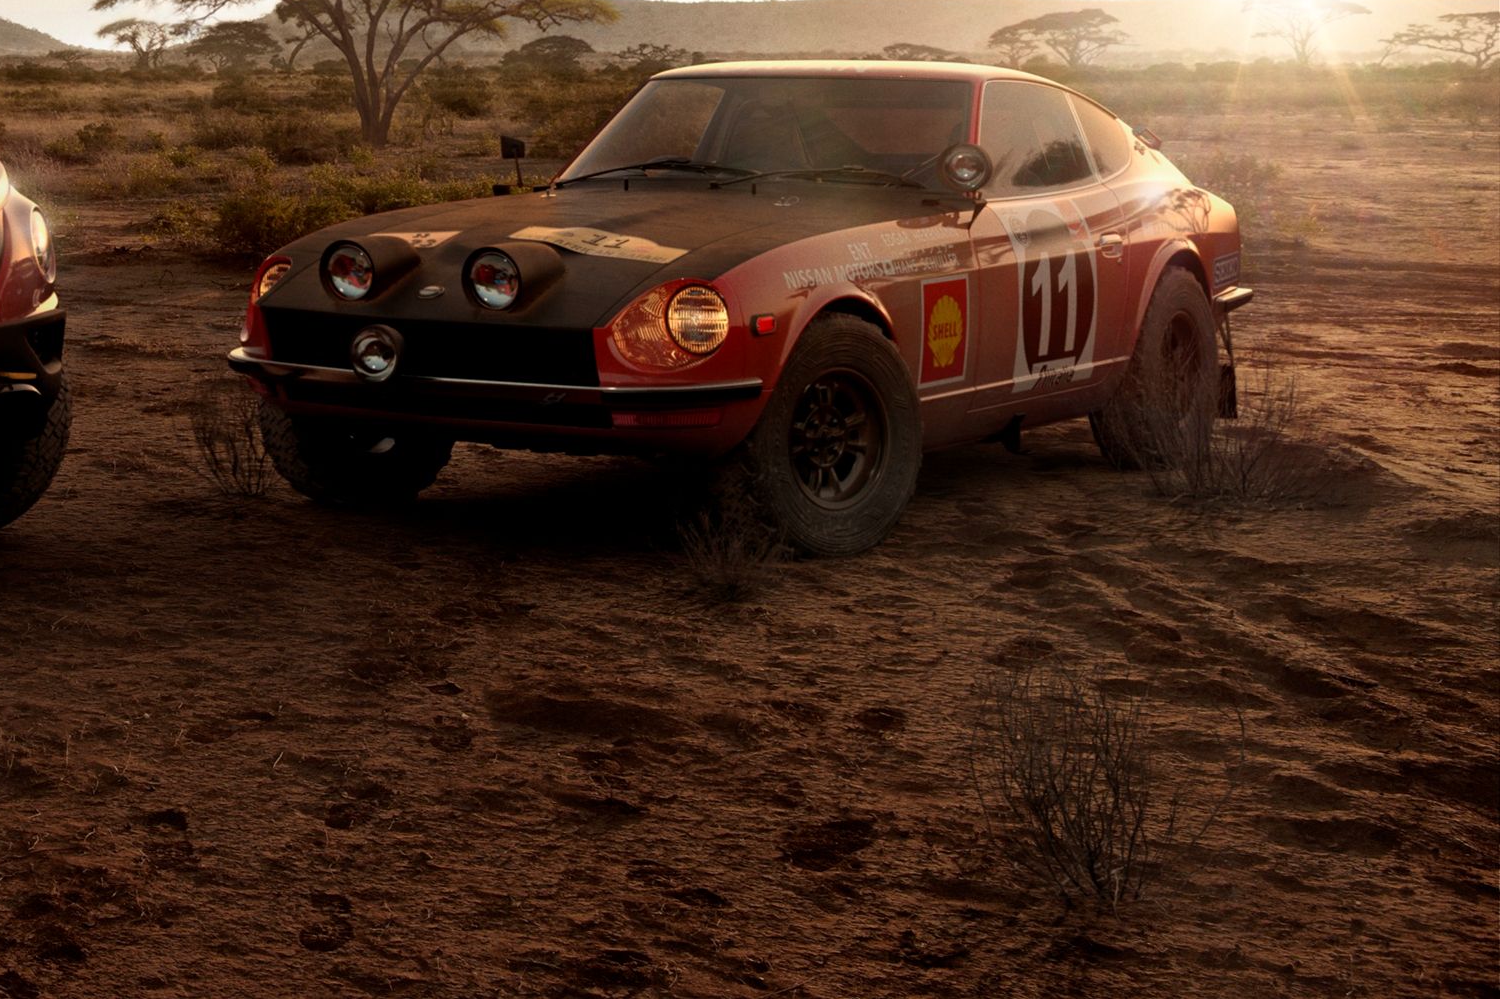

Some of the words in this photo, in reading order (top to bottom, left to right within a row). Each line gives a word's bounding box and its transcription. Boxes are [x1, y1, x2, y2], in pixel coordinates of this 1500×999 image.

[581, 233, 629, 249] 11
[783, 265, 834, 290] NISSAN
[834, 260, 885, 284] MOTORS
[895, 258, 919, 275] HANS
[1031, 250, 1078, 357] 11
[932, 321, 958, 341] SHELL
